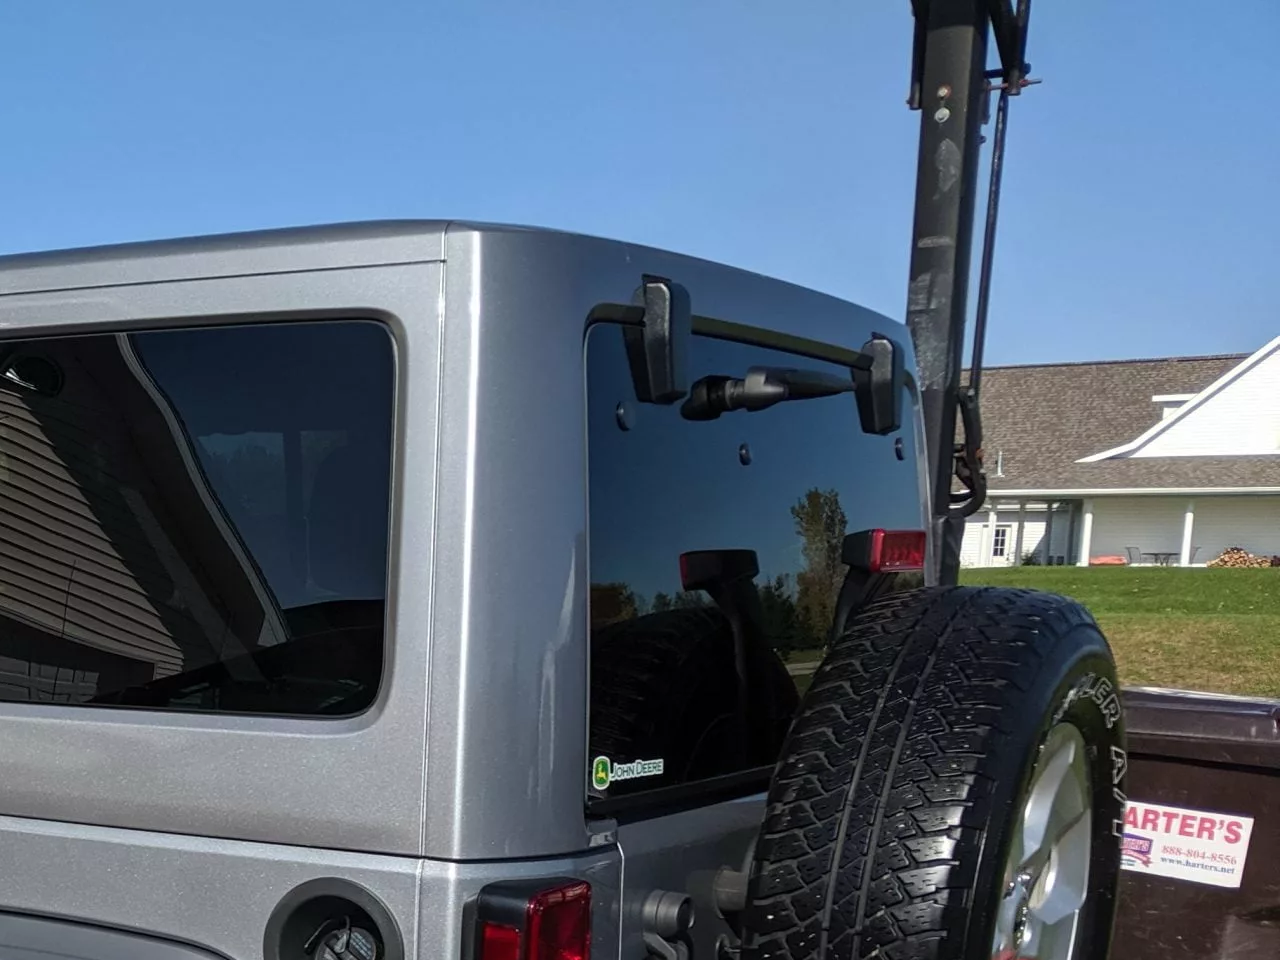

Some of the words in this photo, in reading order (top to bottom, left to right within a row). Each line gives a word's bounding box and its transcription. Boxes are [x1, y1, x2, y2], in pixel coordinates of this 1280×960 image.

[611, 763, 635, 779] JOHN
[636, 761, 663, 775] DEERE
[1160, 856, 1236, 875] www.harters.net
